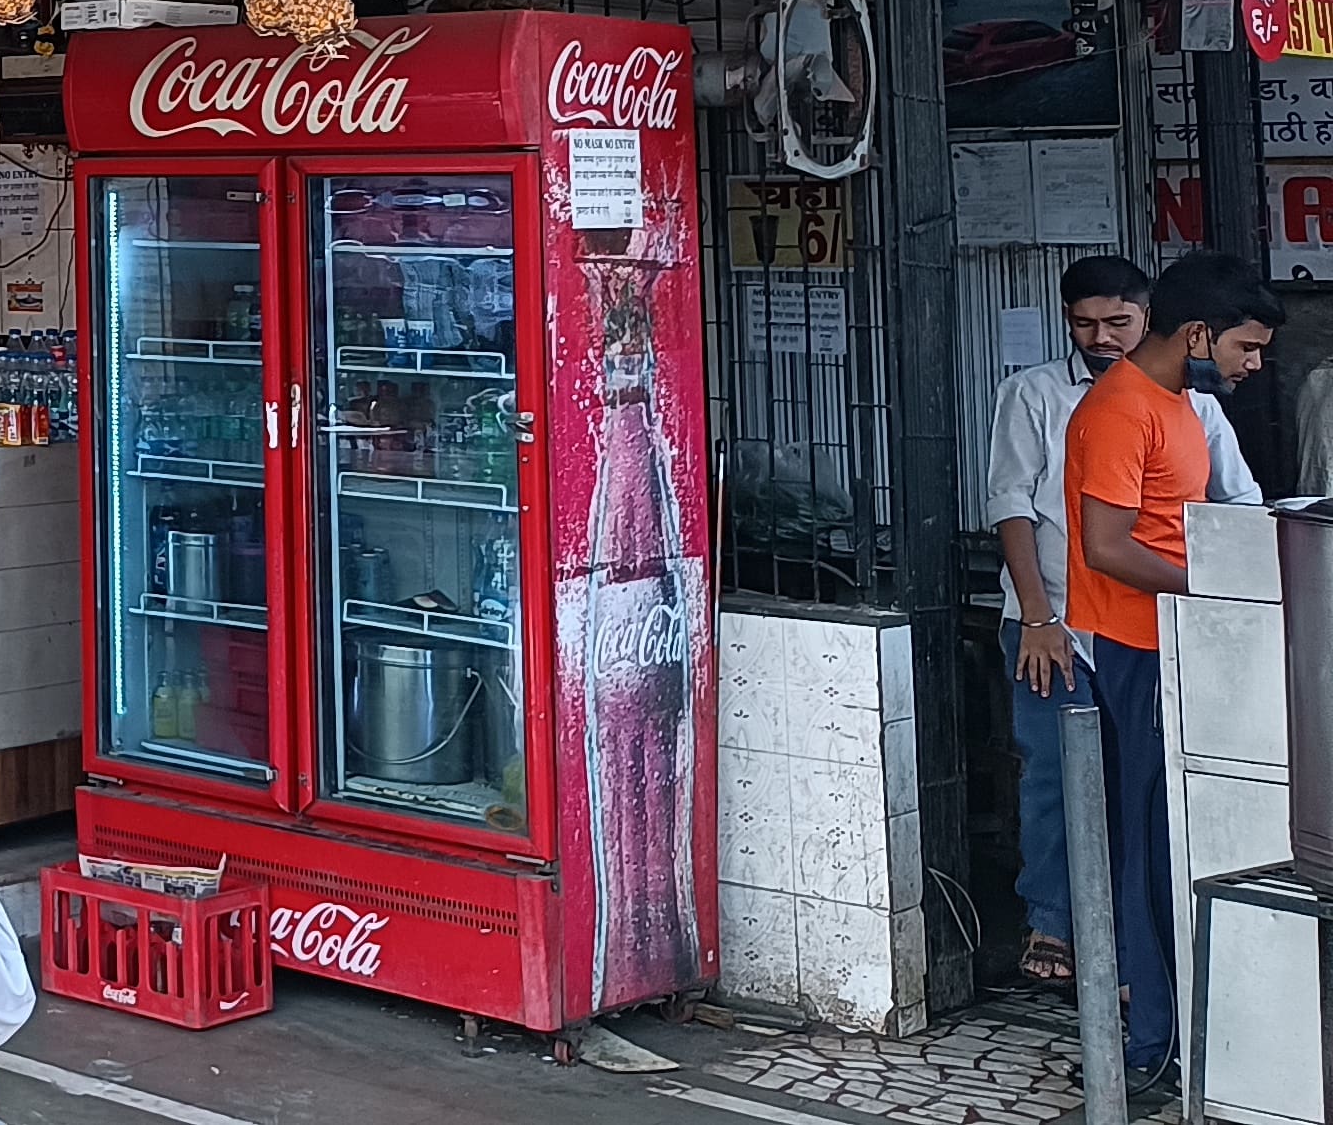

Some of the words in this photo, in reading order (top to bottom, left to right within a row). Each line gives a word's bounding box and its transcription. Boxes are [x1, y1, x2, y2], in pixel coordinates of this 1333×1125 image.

[130, 26, 433, 138] Coca-Cola
[547, 39, 685, 129] Coca-Cola
[0, 171, 11, 179] NO
[574, 139, 583, 148] NO
[585, 139, 603, 148] MASK
[605, 139, 613, 148] NO
[744, 181, 841, 212] चहा
[594, 604, 684, 679] Coca-Cola
[270, 902, 390, 977] a-Cola
